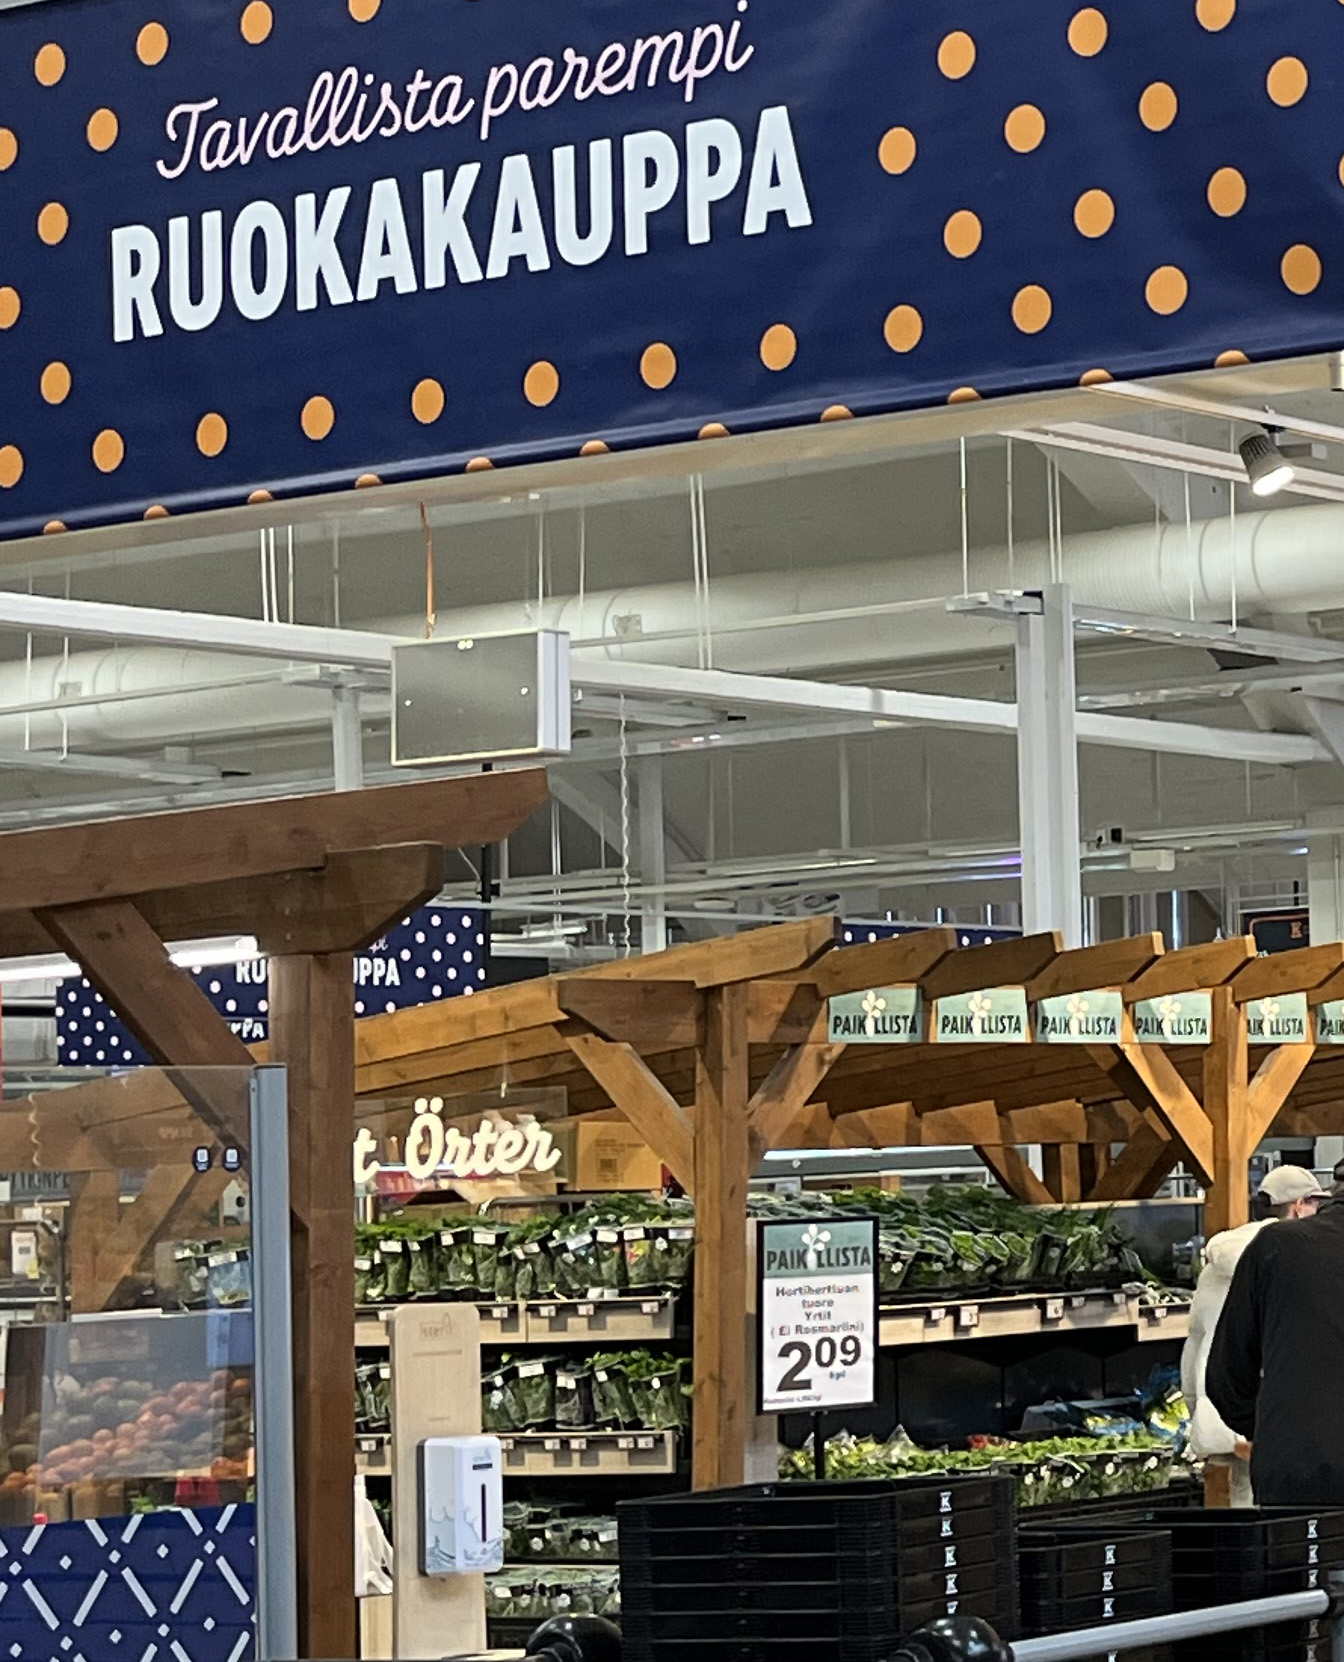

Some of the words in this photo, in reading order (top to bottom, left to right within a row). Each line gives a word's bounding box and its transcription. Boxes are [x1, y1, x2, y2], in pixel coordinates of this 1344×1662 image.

[156, 66, 475, 179] Tavallista
[478, 0, 755, 140] parempi
[111, 105, 813, 343] RUOKAKAUPPA
[405, 1096, 562, 1179] Örter
